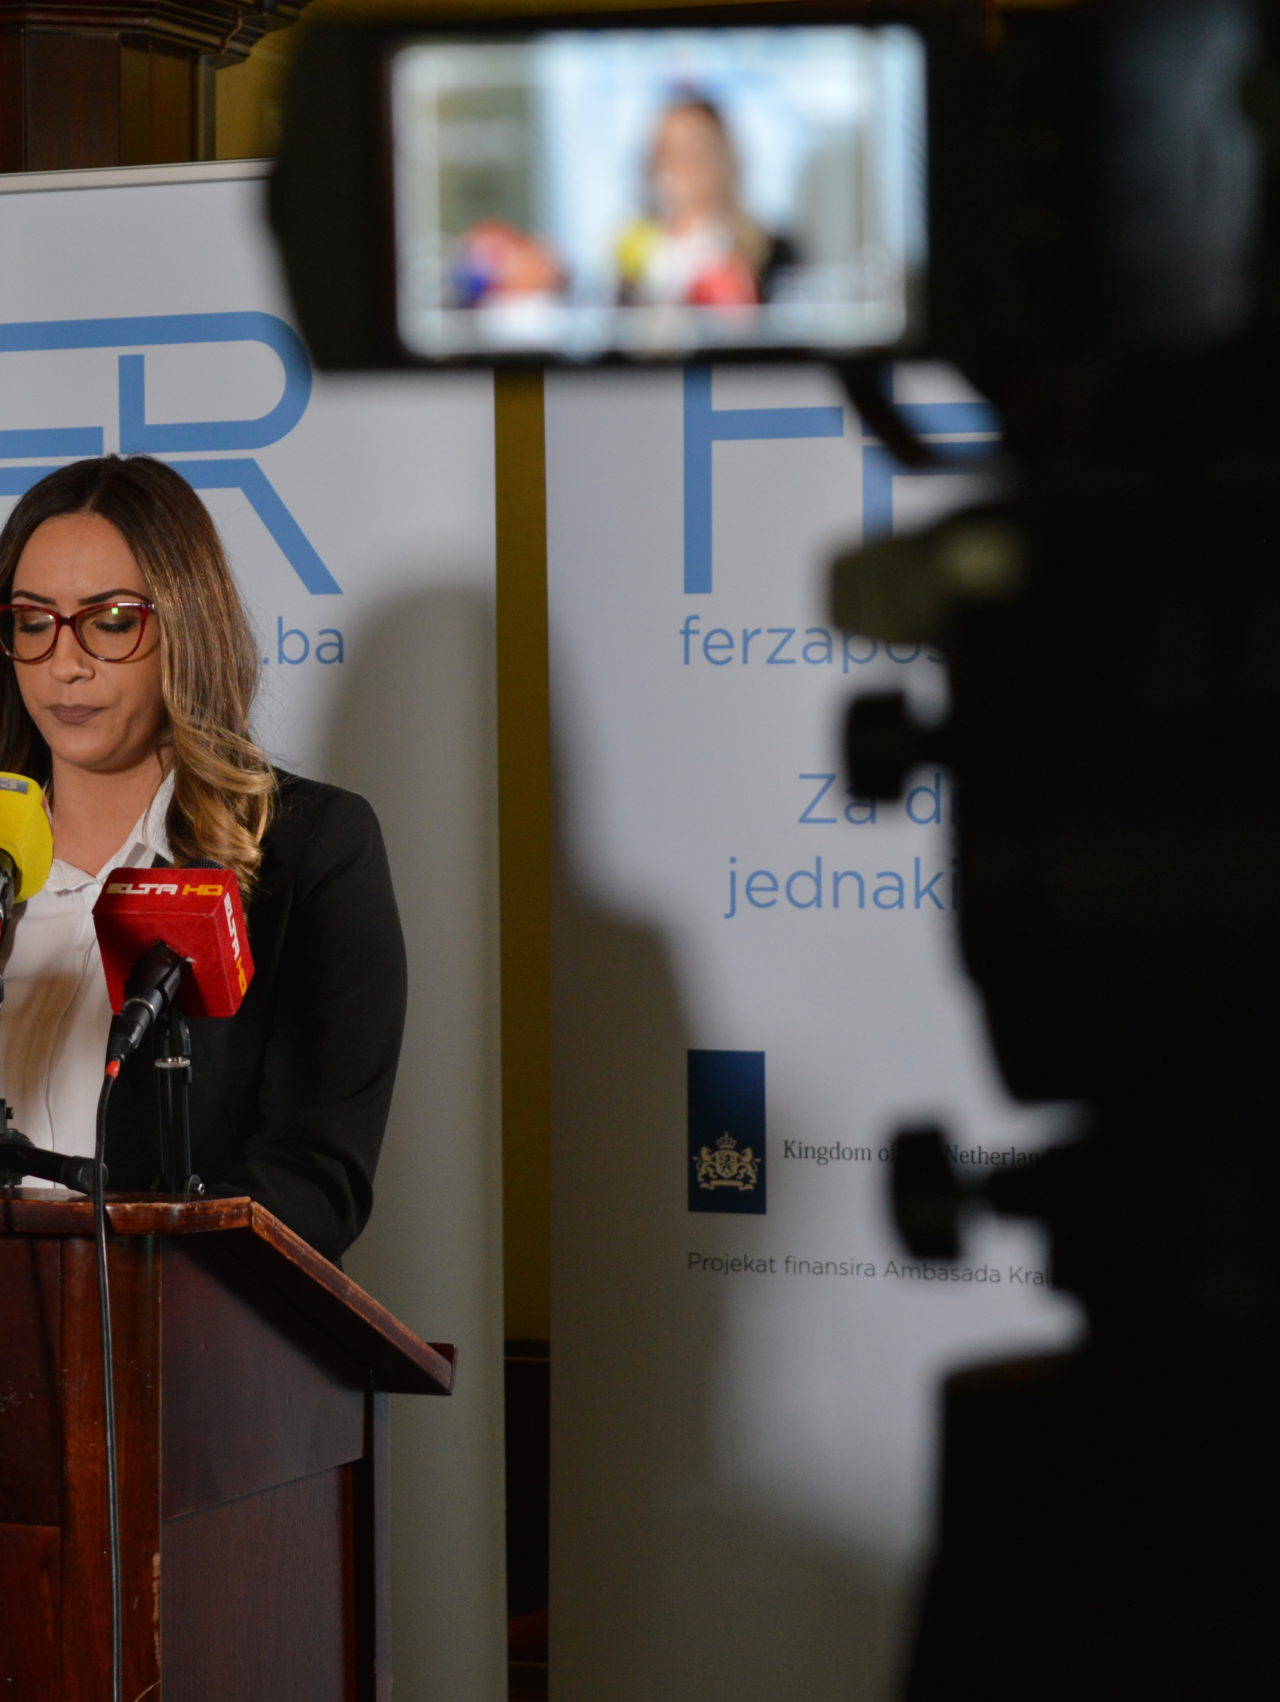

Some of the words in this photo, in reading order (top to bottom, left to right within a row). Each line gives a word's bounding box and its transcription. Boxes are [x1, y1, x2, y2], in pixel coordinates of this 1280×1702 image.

[106, 883, 178, 895] ELTA
[182, 884, 223, 896] HD
[784, 1139, 872, 1165] Kingdom
[688, 1252, 776, 1276] Projekat
[784, 1255, 876, 1277] finansira
[883, 1260, 1001, 1283] Ambasada
